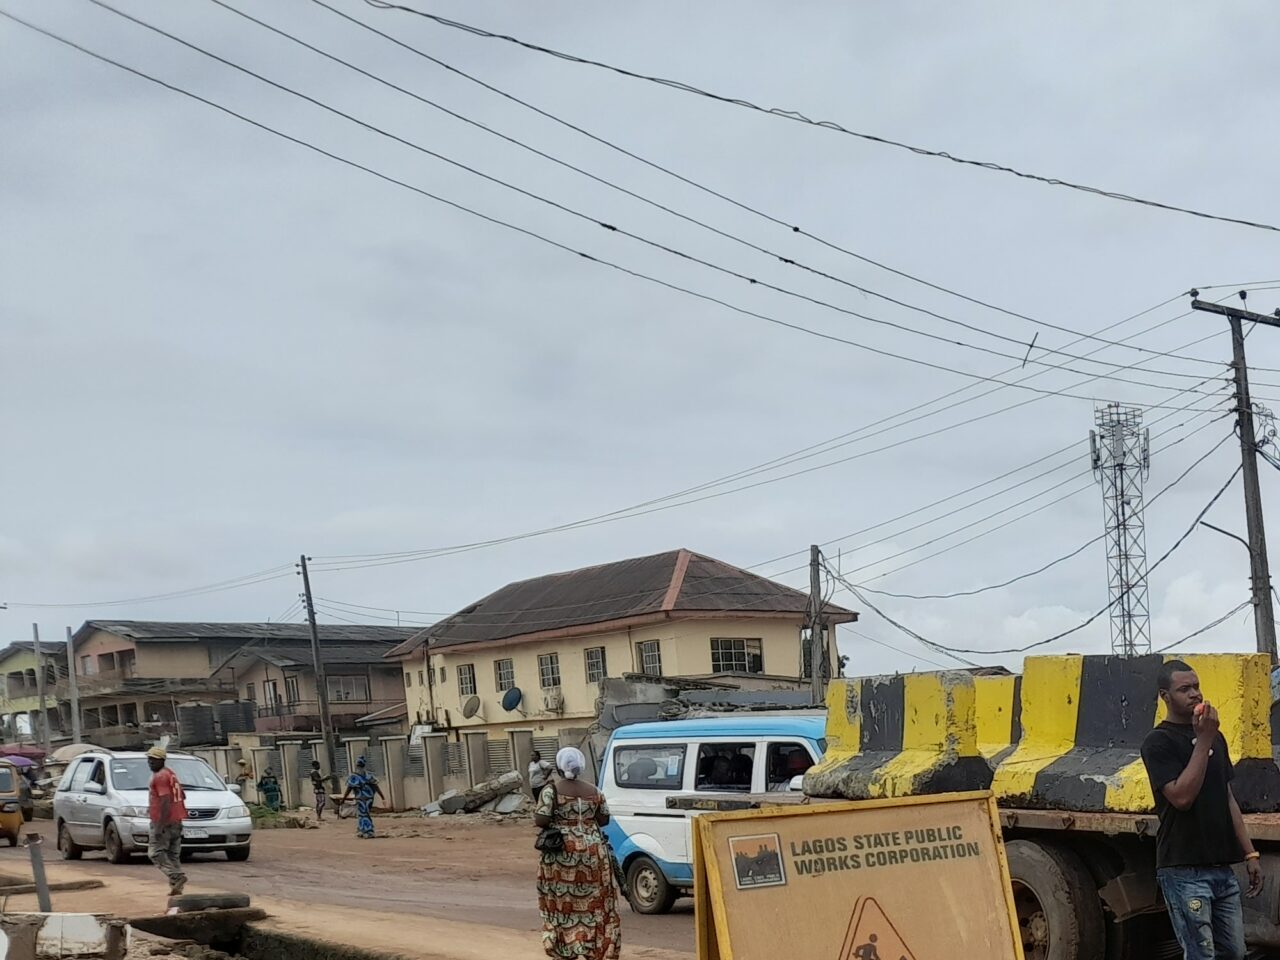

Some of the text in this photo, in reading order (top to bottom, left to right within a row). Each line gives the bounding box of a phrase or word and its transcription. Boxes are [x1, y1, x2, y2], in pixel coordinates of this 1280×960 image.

[790, 825, 963, 857] LAGOS STATE PUBLIC
[793, 842, 980, 876] WORKS CORPORATION
